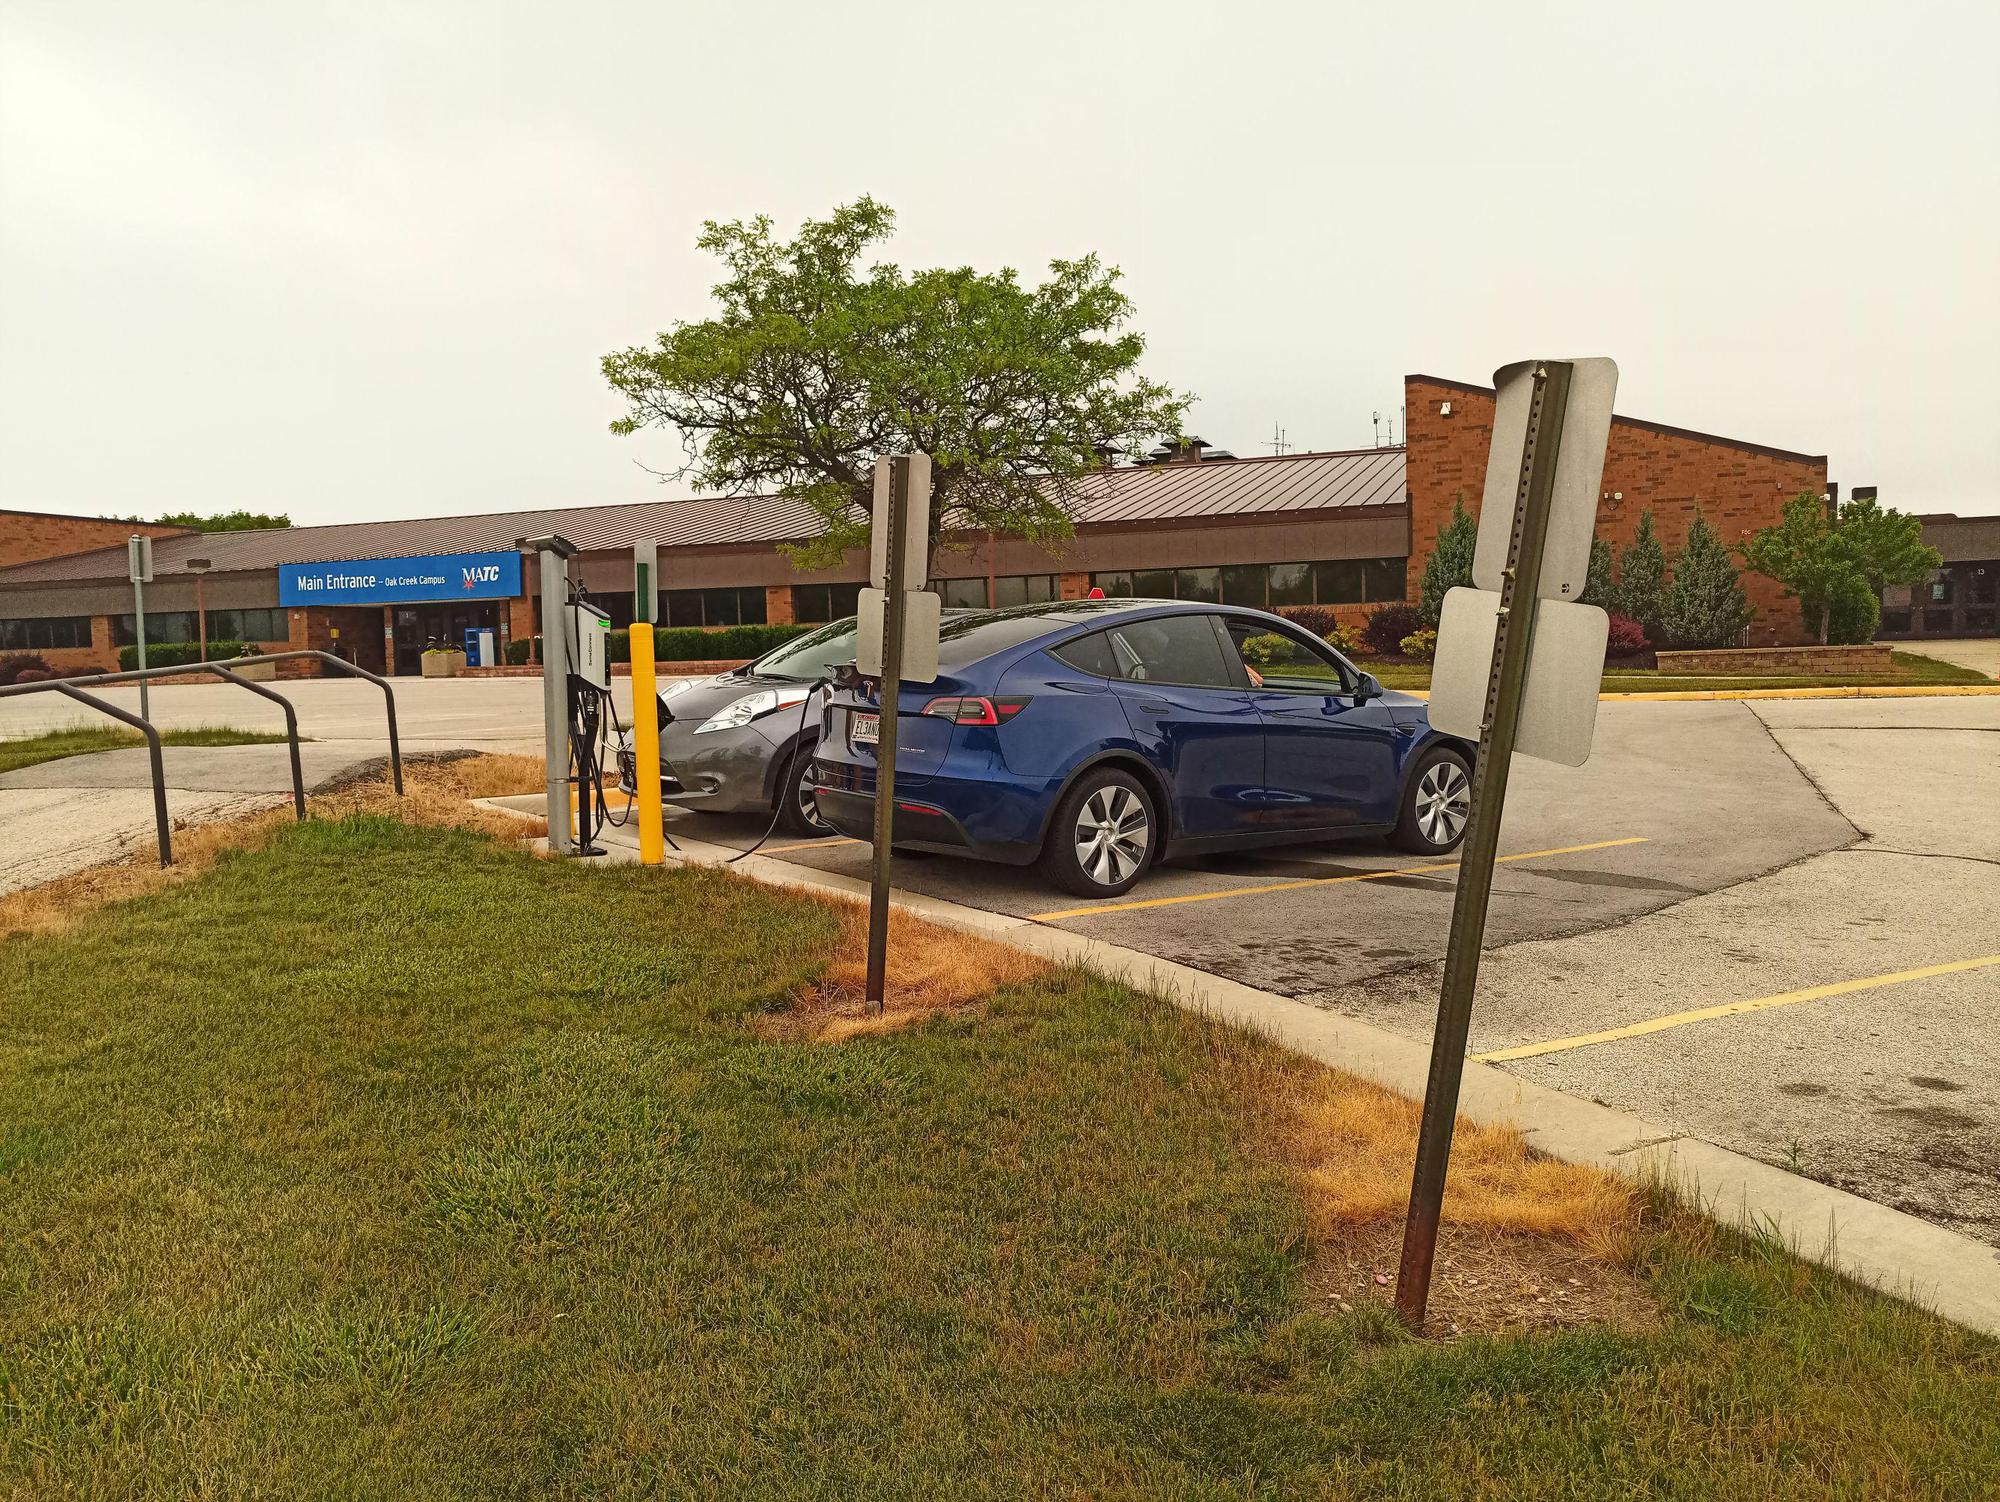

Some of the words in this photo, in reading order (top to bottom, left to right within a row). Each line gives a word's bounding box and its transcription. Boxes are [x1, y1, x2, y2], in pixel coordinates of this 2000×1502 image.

[297, 575, 323, 591] Main
[326, 573, 376, 590] Entrance
[385, 577, 398, 587] Oak
[399, 576, 418, 586] Creek
[419, 575, 446, 586] Campus
[462, 565, 500, 583] MATC
